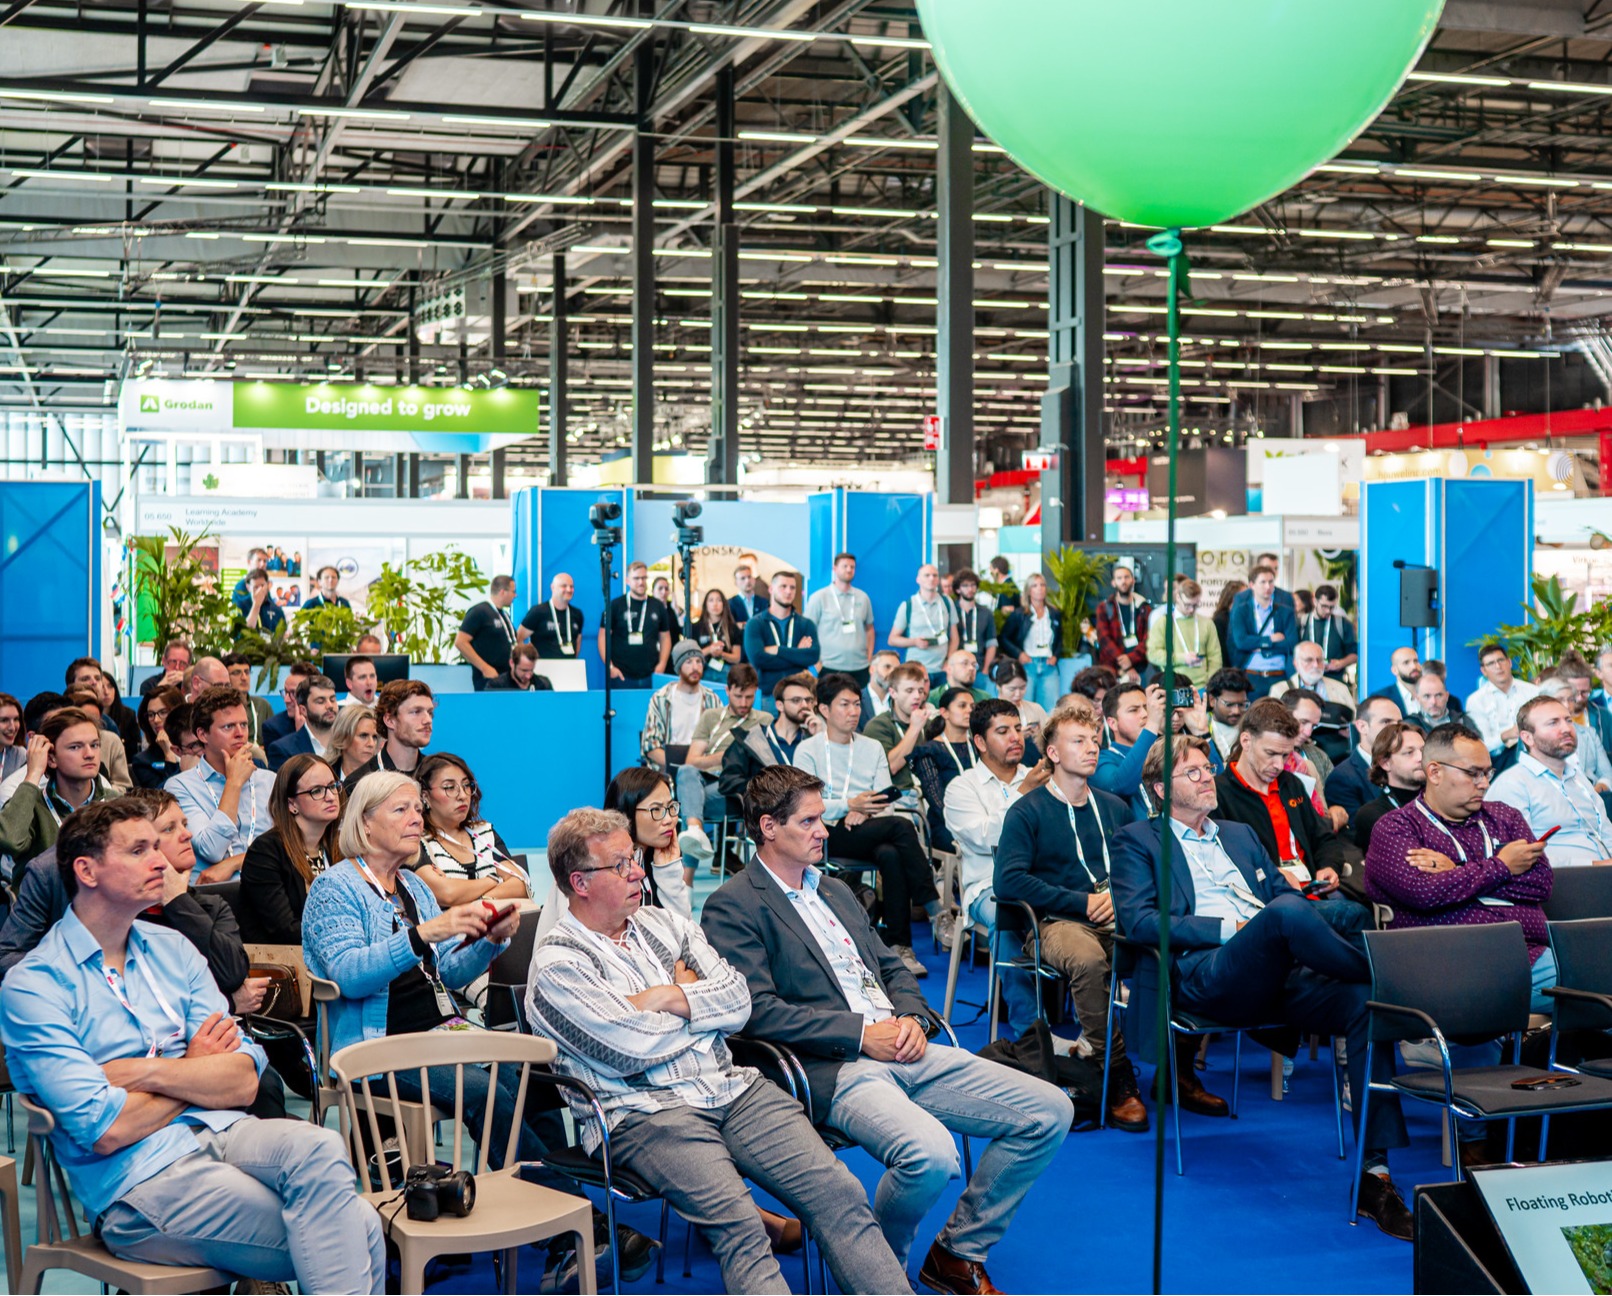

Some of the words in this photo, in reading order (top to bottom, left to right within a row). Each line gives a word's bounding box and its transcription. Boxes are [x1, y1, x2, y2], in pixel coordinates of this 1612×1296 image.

[164, 398, 213, 410] Grodan
[305, 396, 392, 419] Designed
[397, 400, 418, 415] to
[422, 402, 471, 420] grow
[185, 508, 220, 518] Learning
[221, 508, 258, 518] Academy
[1505, 1194, 1569, 1212] Floating
[1567, 1189, 1612, 1207] Robot
